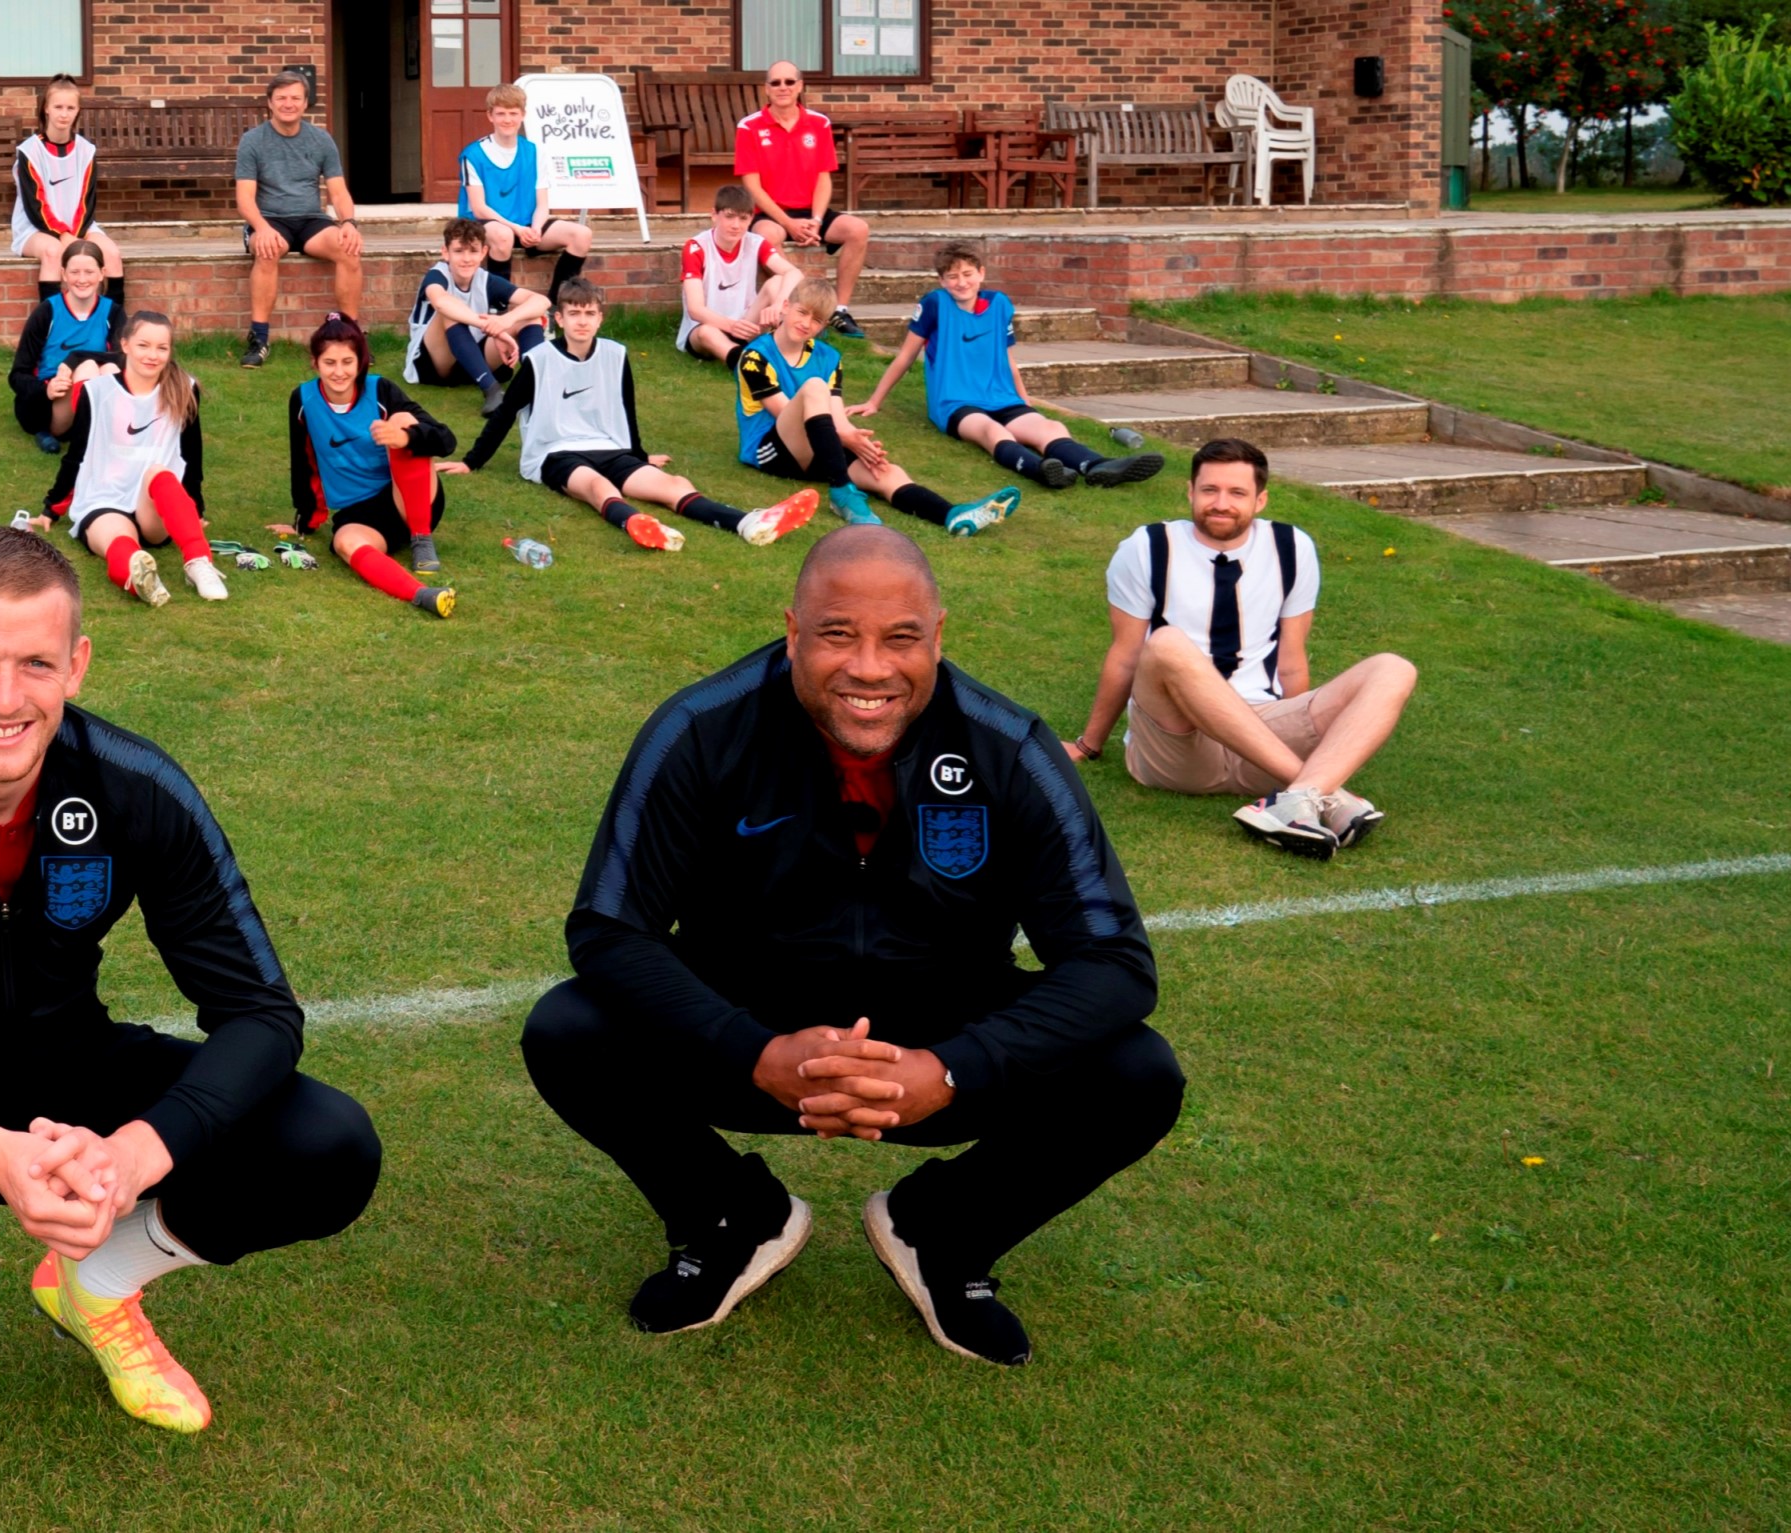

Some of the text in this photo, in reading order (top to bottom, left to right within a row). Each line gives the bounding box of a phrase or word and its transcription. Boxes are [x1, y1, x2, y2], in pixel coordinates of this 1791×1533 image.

[535, 96, 595, 120] We only
[541, 118, 615, 144] positive.
[940, 765, 965, 783] BT
[62, 812, 87, 830] BT
